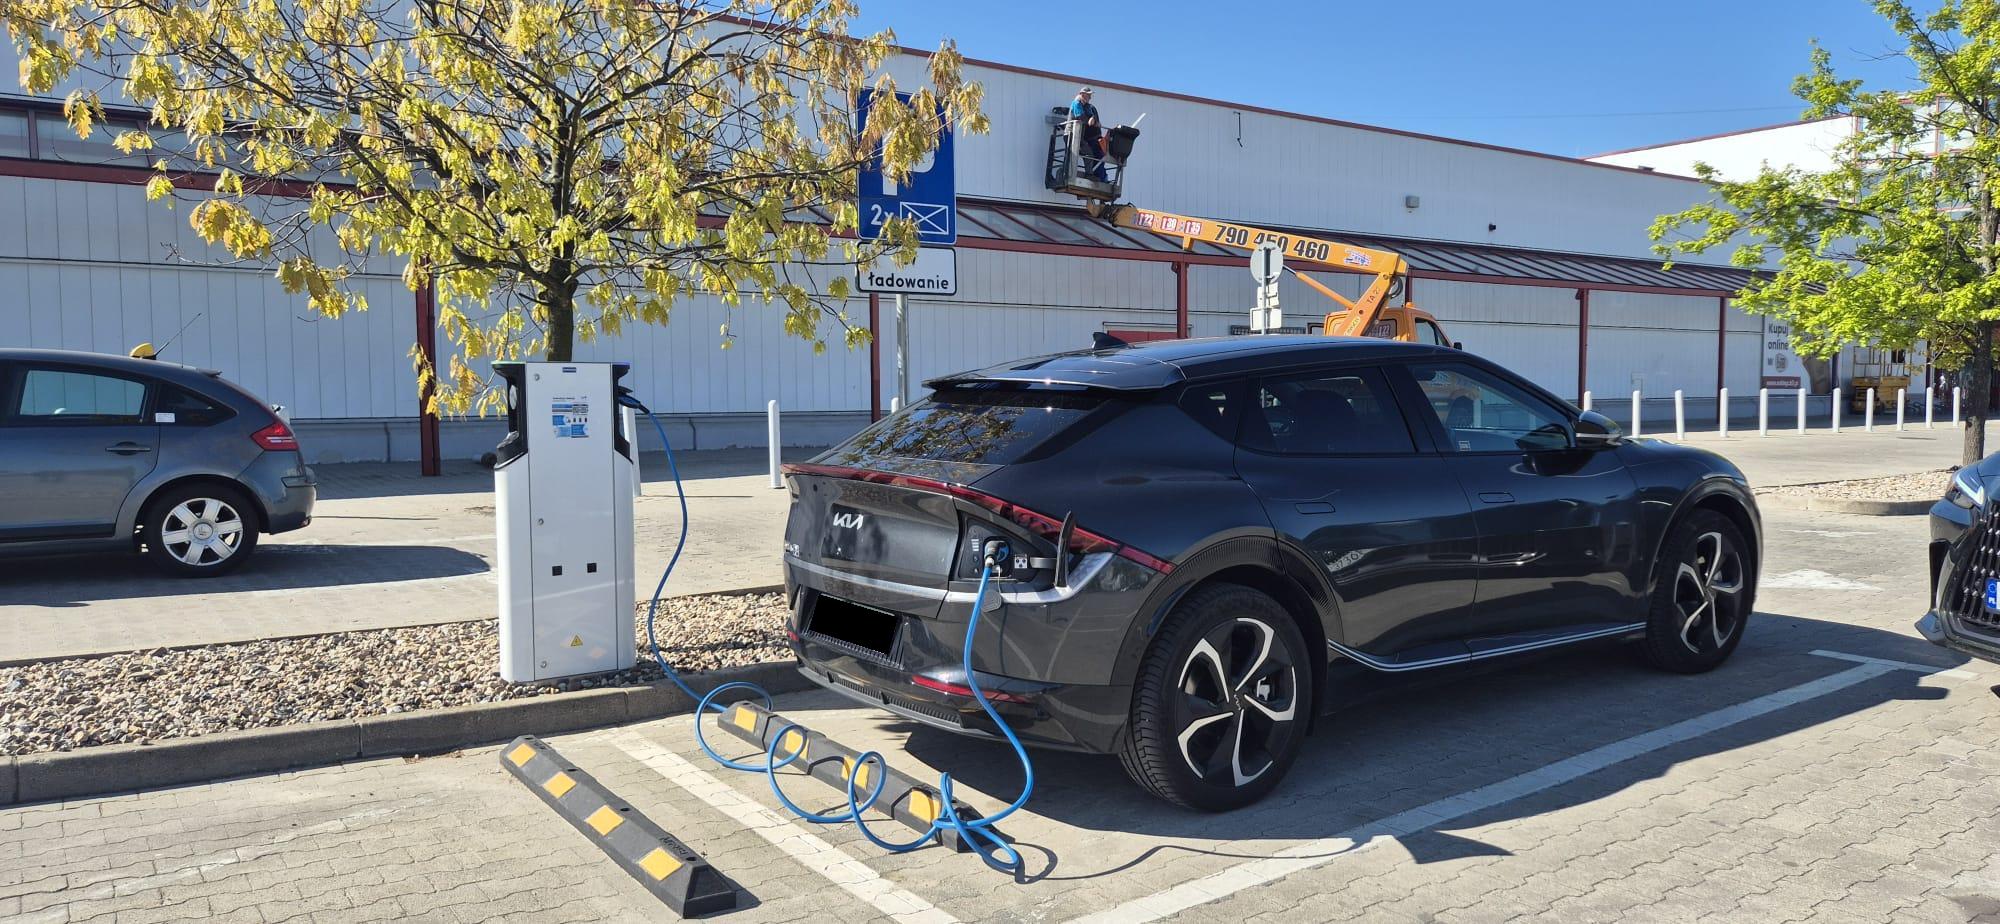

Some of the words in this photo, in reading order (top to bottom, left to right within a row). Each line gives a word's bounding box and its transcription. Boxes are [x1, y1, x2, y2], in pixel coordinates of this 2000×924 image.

[1214, 224, 1249, 246] 790
[1293, 239, 1330, 261] 460
[868, 271, 949, 289] ładowanie
[1768, 322, 1789, 338] Kupuj
[1767, 339, 1789, 350] online
[832, 511, 864, 530] KIA
